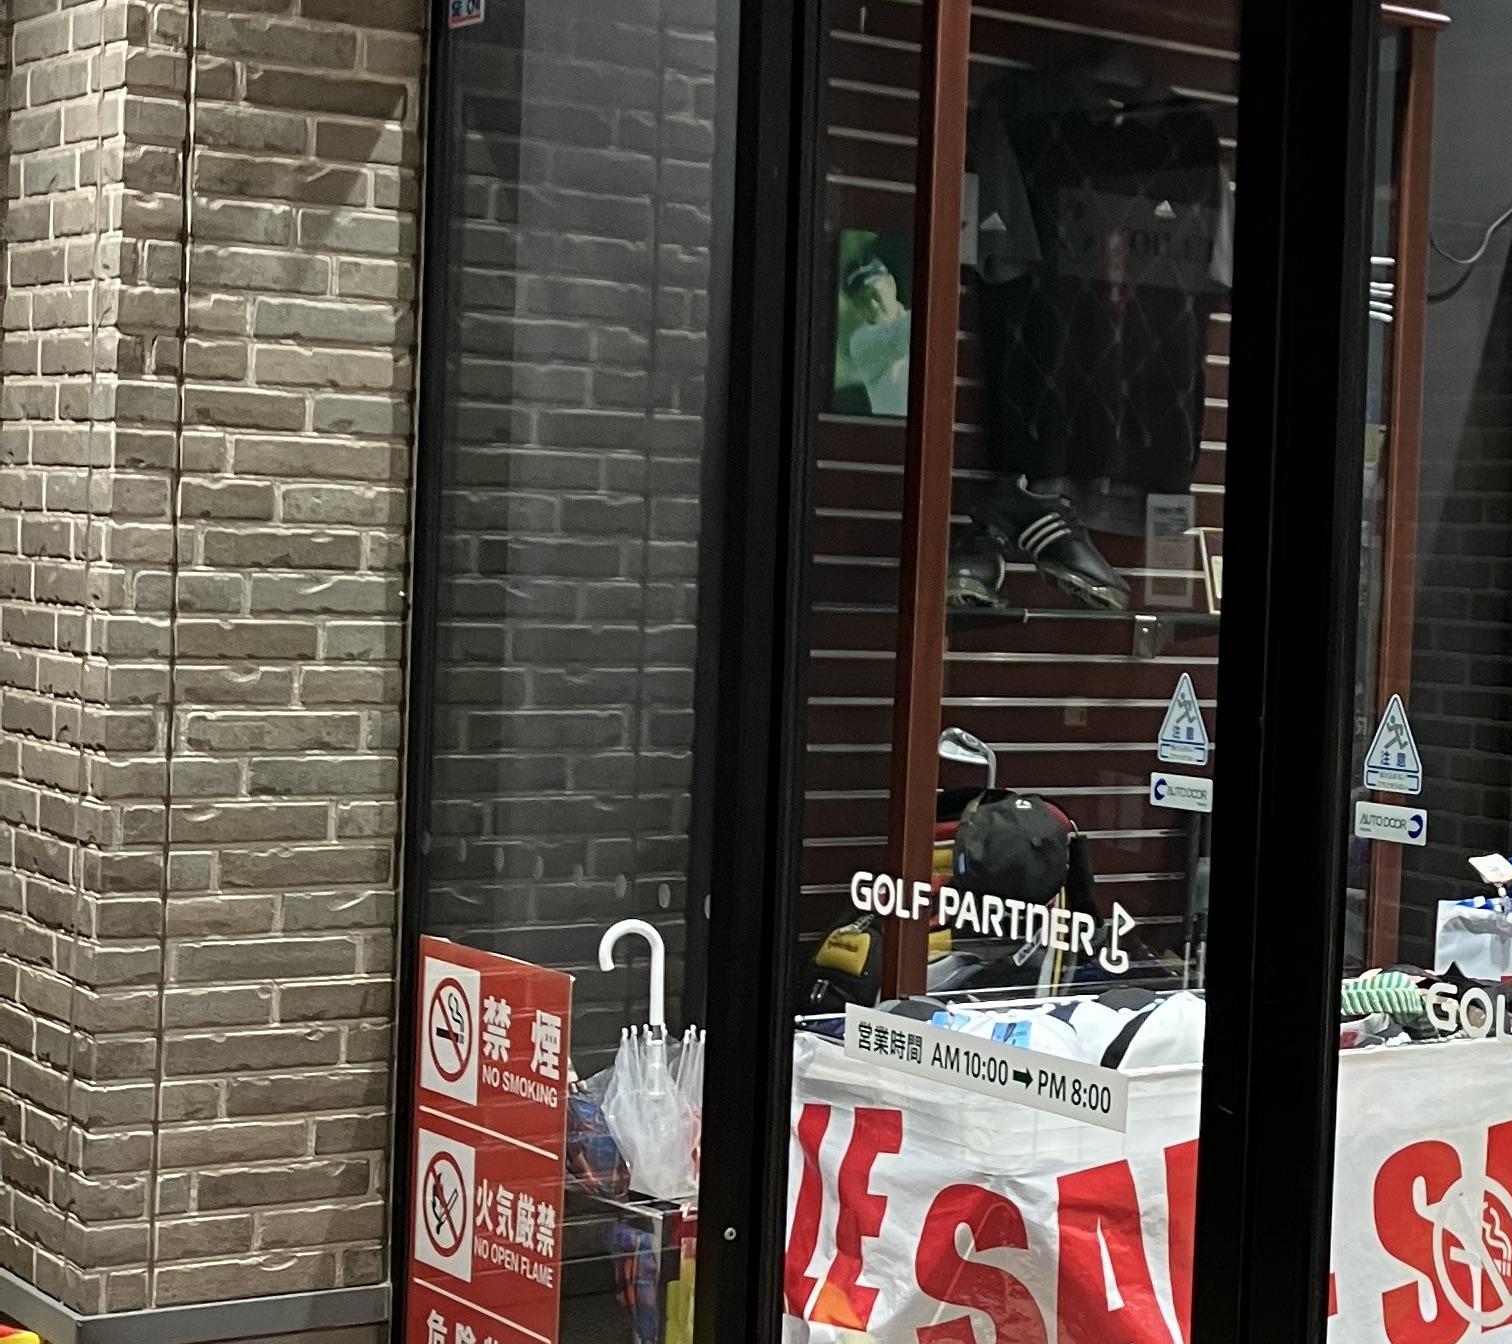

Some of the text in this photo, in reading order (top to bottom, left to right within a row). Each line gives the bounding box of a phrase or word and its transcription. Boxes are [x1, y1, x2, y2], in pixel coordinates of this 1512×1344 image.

[1359, 812, 1382, 827] AUTO
[1383, 816, 1407, 831] DOOR
[850, 870, 1096, 957] GOLF PARTNER
[482, 994, 562, 1081] 禁煙
[857, 1020, 923, 1065] 営業時間
[482, 1064, 558, 1108] NO SMOKING
[930, 1041, 1113, 1114] AM 10:00 PM 8:00
[475, 1178, 556, 1258] 火気厳禁
[474, 1236, 553, 1289] NO OPEN FLAME
